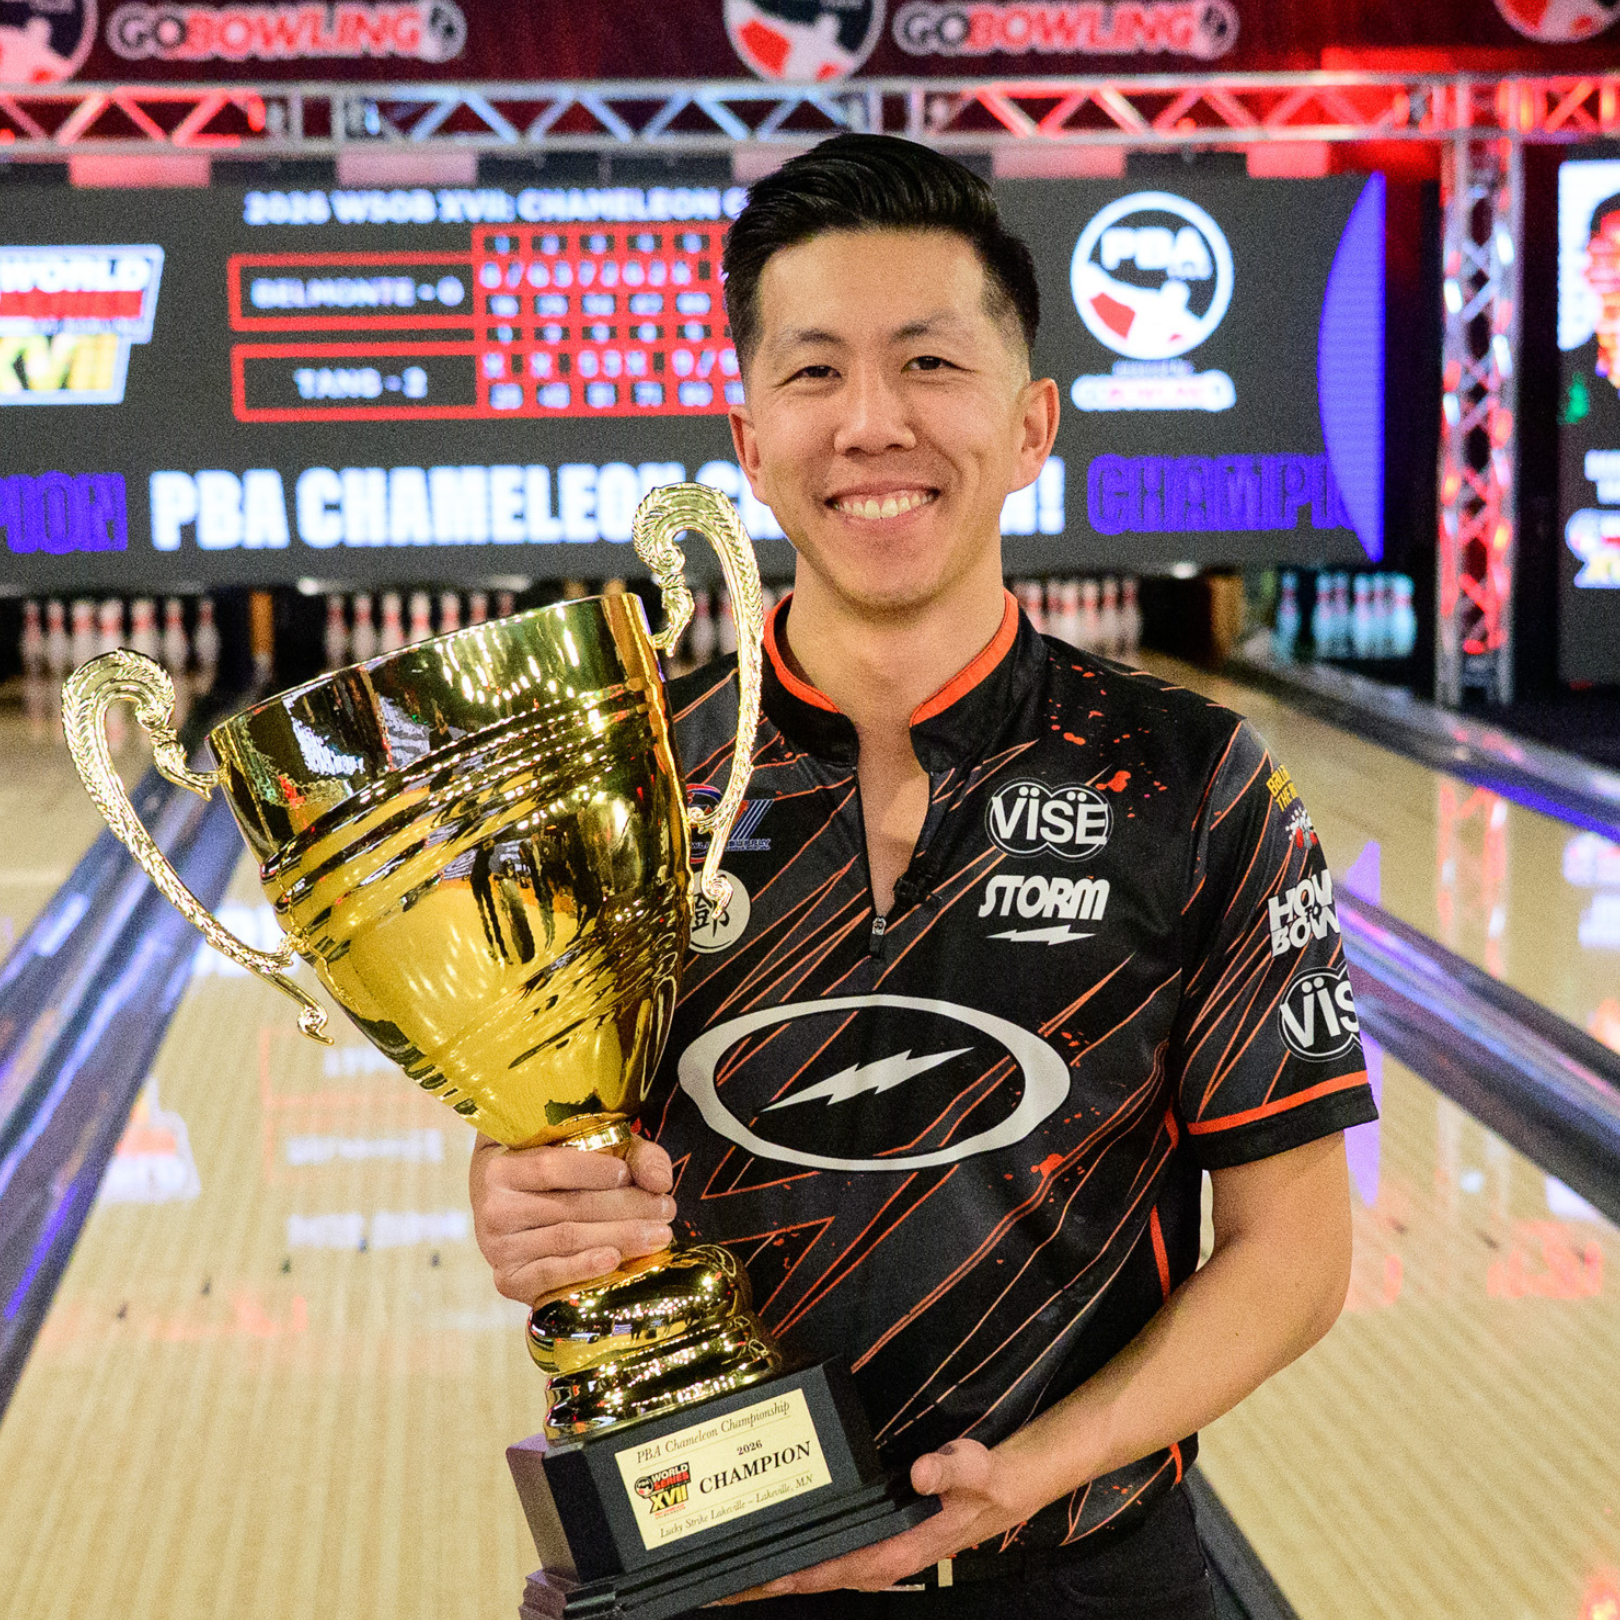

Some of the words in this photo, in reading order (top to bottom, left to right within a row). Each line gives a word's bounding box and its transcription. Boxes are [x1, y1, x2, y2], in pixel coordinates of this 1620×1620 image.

[517, 187, 720, 221] CHAMELEON
[1100, 226, 1213, 280] PBA
[149, 468, 290, 551] PBA
[978, 874, 1111, 921] STORM
[636, 1444, 662, 1464] PBA
[665, 1429, 718, 1453] Chameleon
[720, 1400, 790, 1433] Championship
[736, 1439, 763, 1456] 2026
[651, 1464, 689, 1482] WORLD
[654, 1471, 690, 1491] SERIES
[699, 1440, 811, 1495] CHAMPION
[650, 1484, 688, 1513] XVII
[659, 1520, 684, 1539] Lucky
[685, 1511, 708, 1529] Strike
[710, 1499, 746, 1520] Lakeville
[795, 1473, 813, 1490] MN
